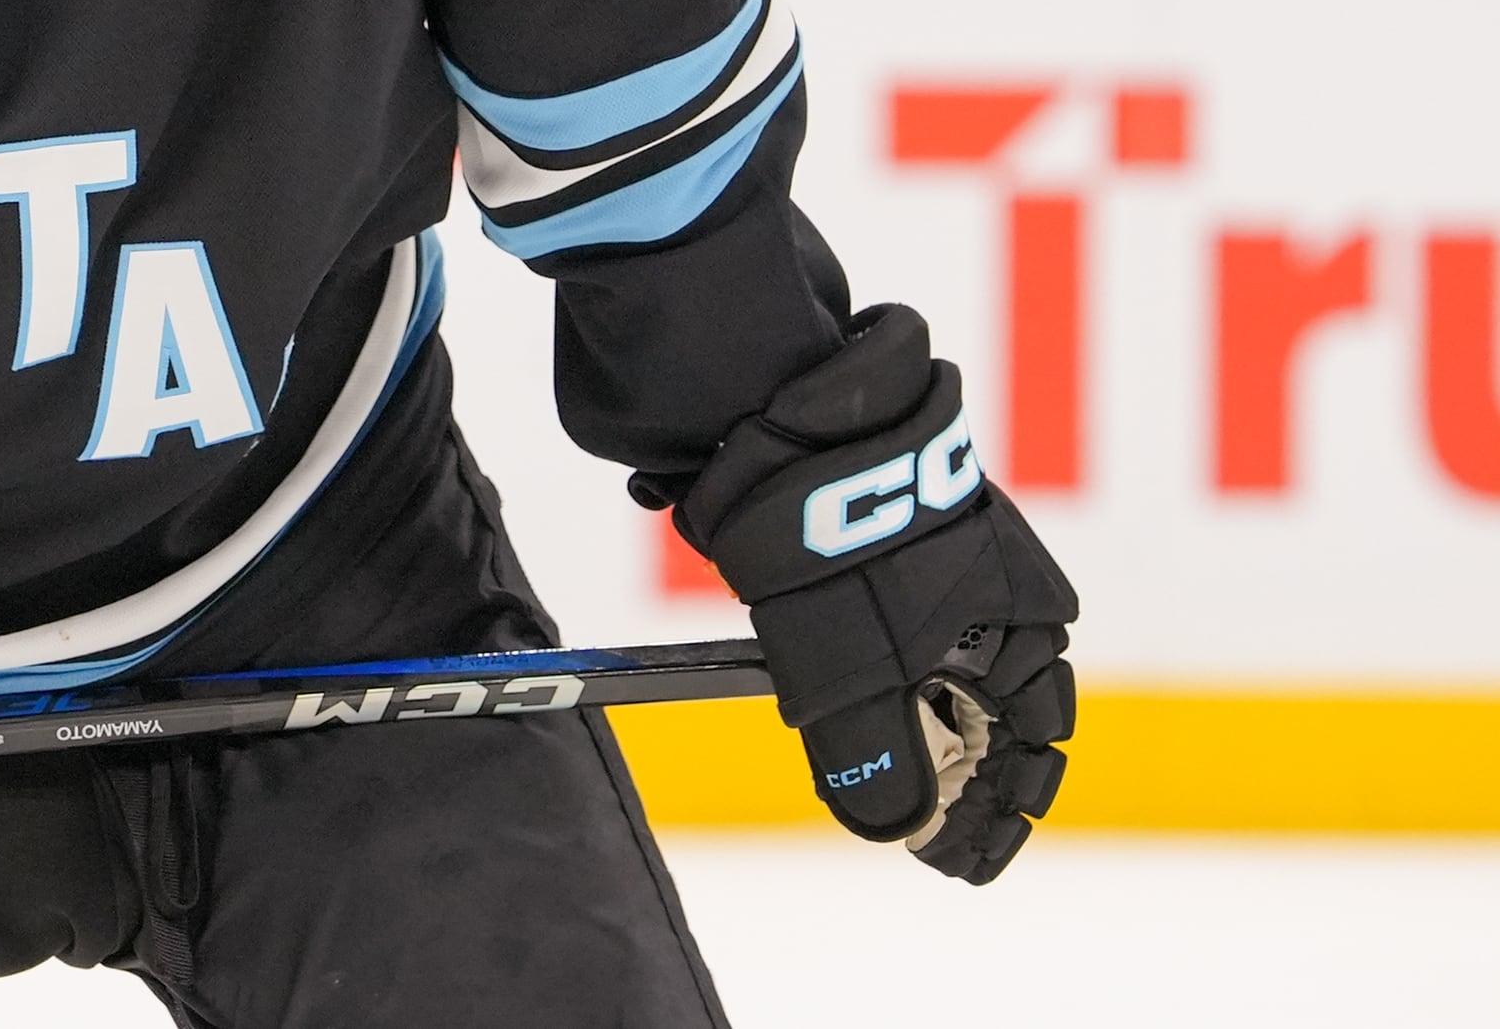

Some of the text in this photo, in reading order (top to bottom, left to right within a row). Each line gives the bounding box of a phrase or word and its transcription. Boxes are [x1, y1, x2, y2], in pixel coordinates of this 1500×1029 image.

[803, 408, 984, 558] CC
[284, 674, 587, 730] CCM
[56, 720, 164, 742] YAMAMOTO
[826, 750, 893, 788] CCM
